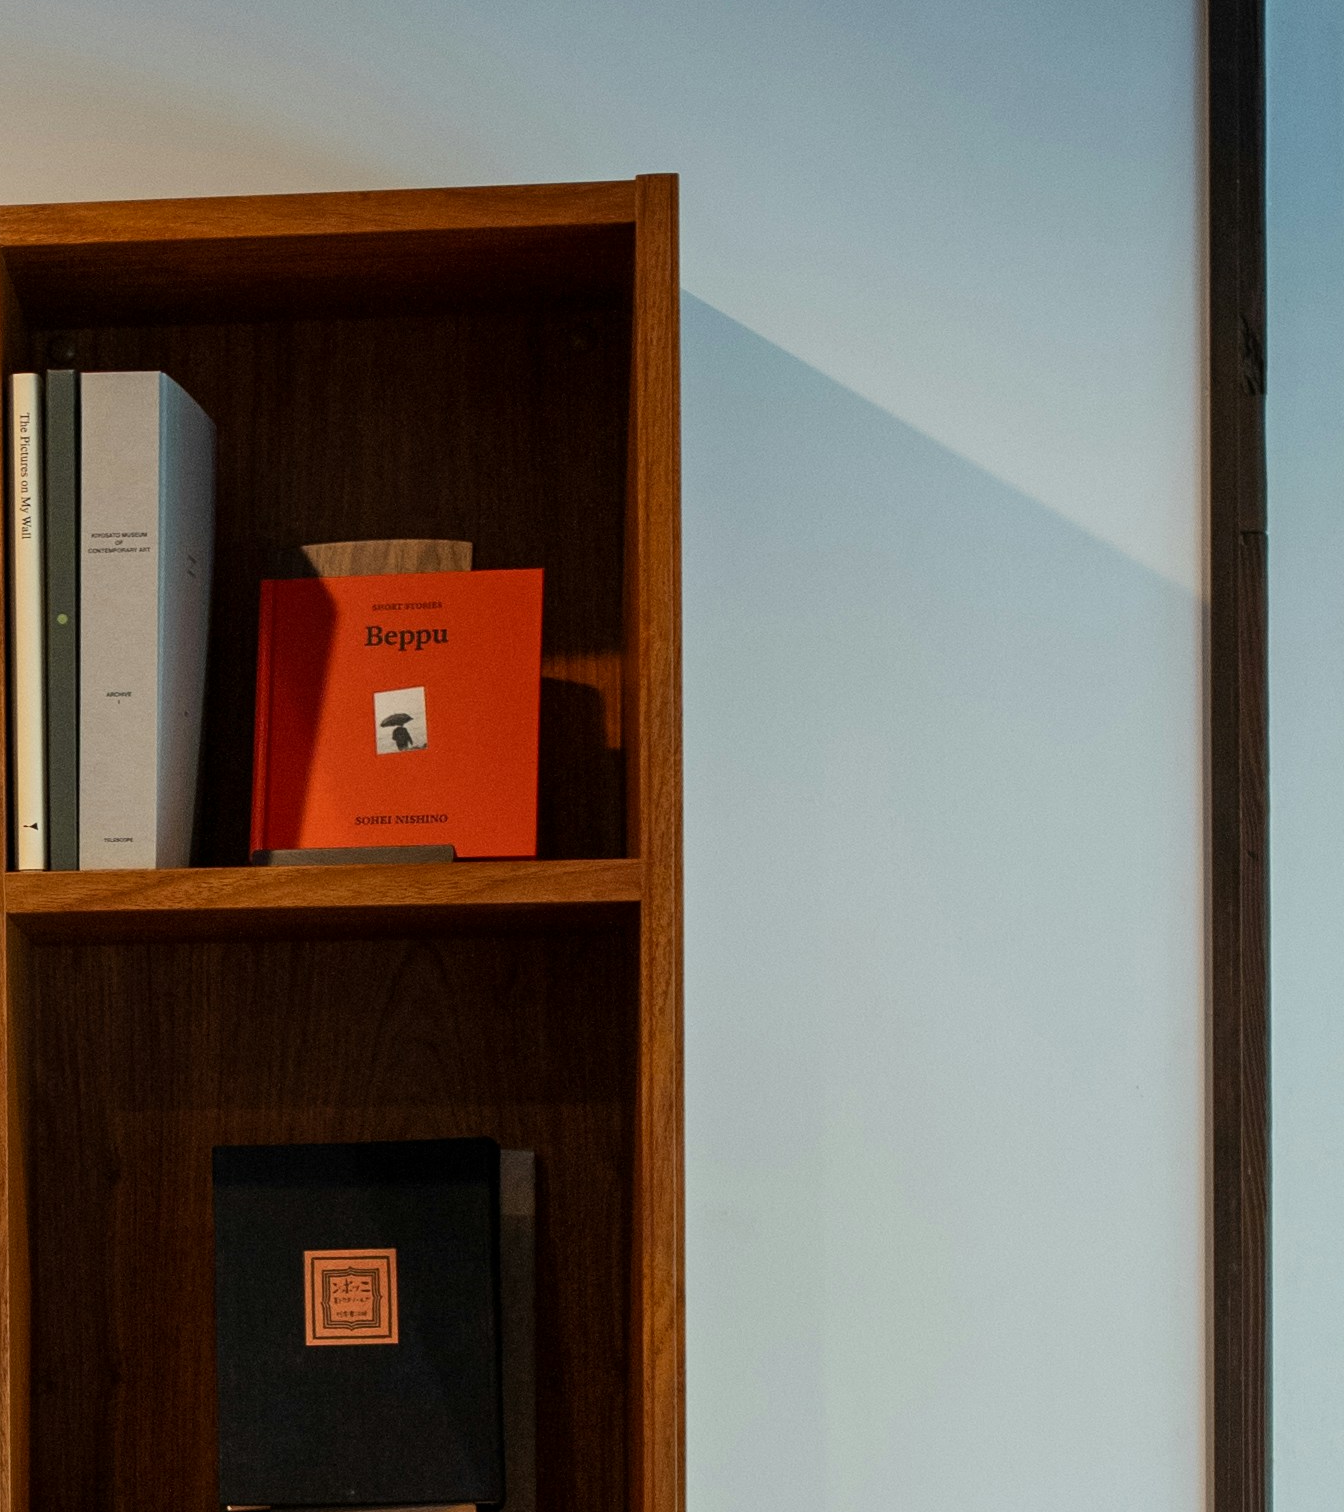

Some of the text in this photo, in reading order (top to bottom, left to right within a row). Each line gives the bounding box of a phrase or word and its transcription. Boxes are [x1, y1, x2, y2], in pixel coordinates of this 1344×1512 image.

[19, 412, 31, 540] The Pictures on My Wall
[365, 625, 449, 651] Beppu
[355, 814, 448, 825] SOHEI NISHINO
